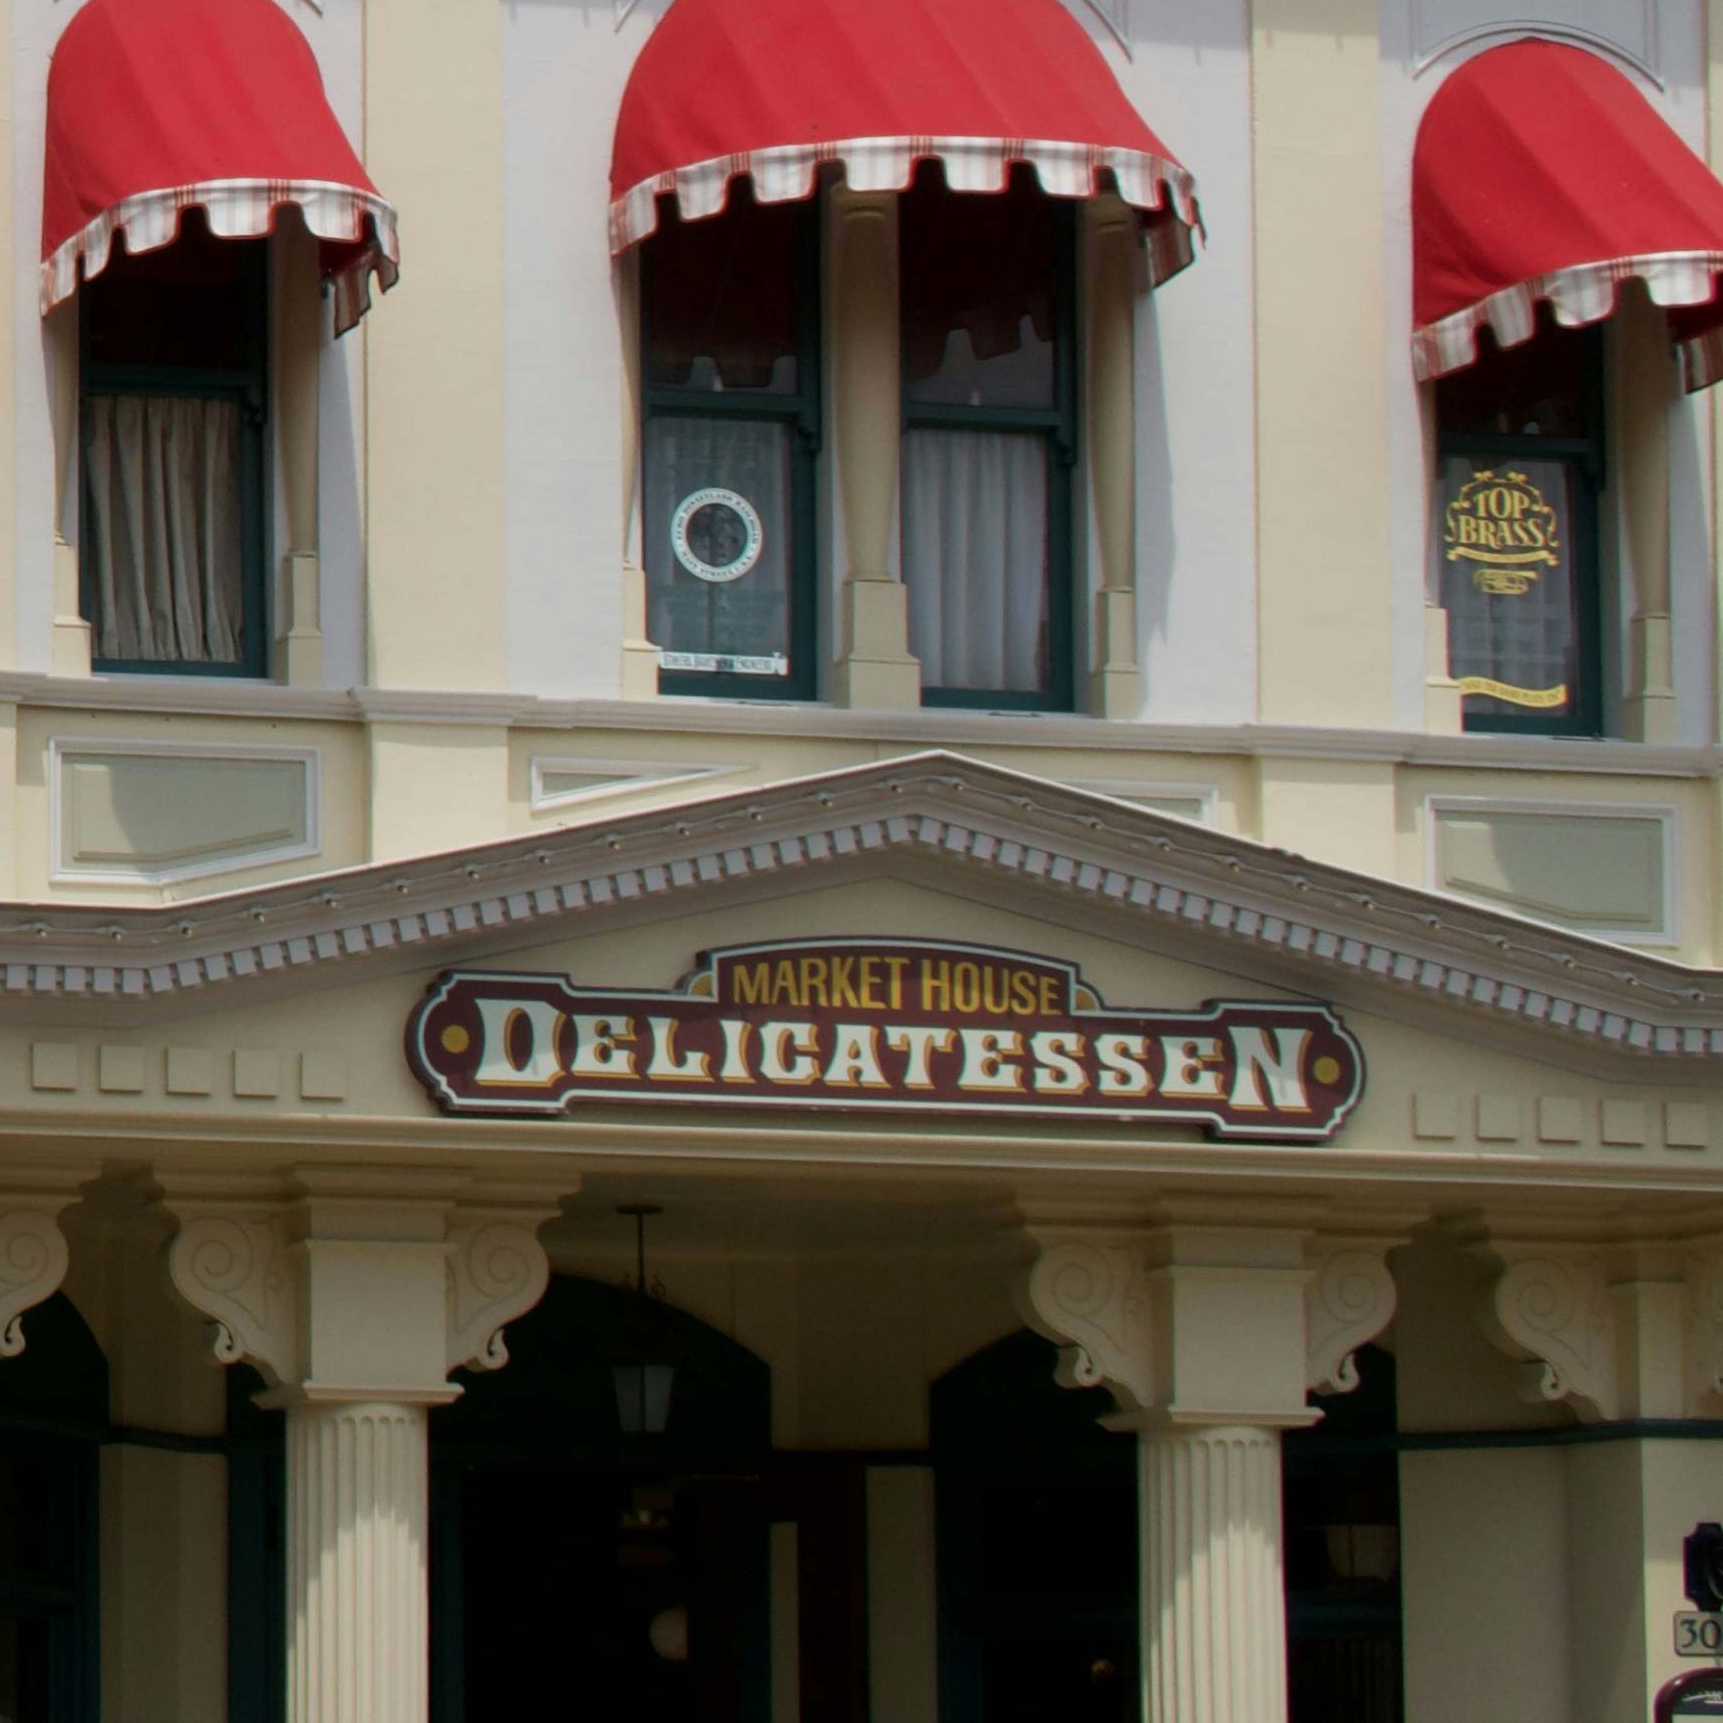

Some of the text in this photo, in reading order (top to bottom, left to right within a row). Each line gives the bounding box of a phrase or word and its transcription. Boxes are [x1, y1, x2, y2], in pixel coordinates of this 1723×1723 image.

[1473, 487, 1531, 520] TOP
[1458, 515, 1547, 550] BRASS
[731, 956, 1061, 1016] MARKET HOUSE
[473, 996, 1314, 1114] DELICATESSEN
